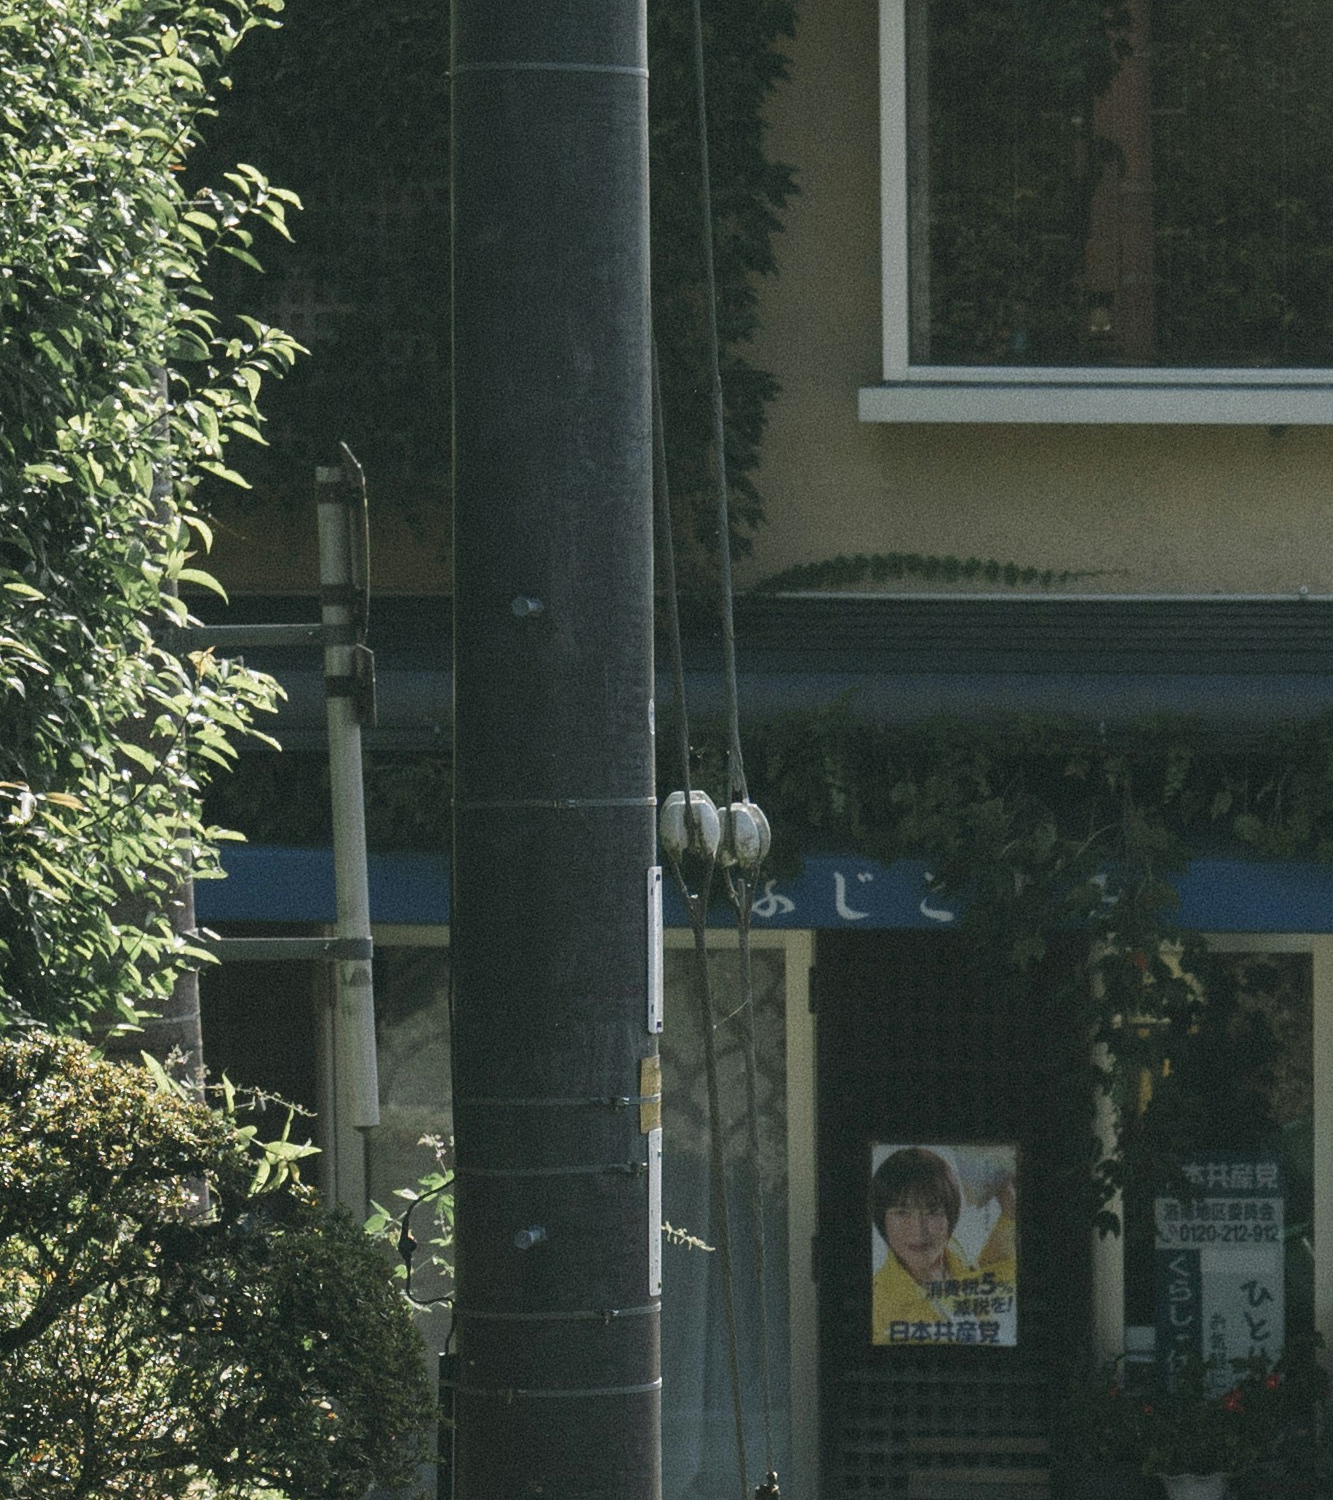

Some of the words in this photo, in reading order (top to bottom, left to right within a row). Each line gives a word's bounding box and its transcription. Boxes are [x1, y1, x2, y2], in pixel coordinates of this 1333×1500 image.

[1180, 1161, 1279, 1189] 本共産党
[1179, 1224, 1279, 1243] 0120-212-912
[889, 1319, 1001, 1343] 日本共産党
